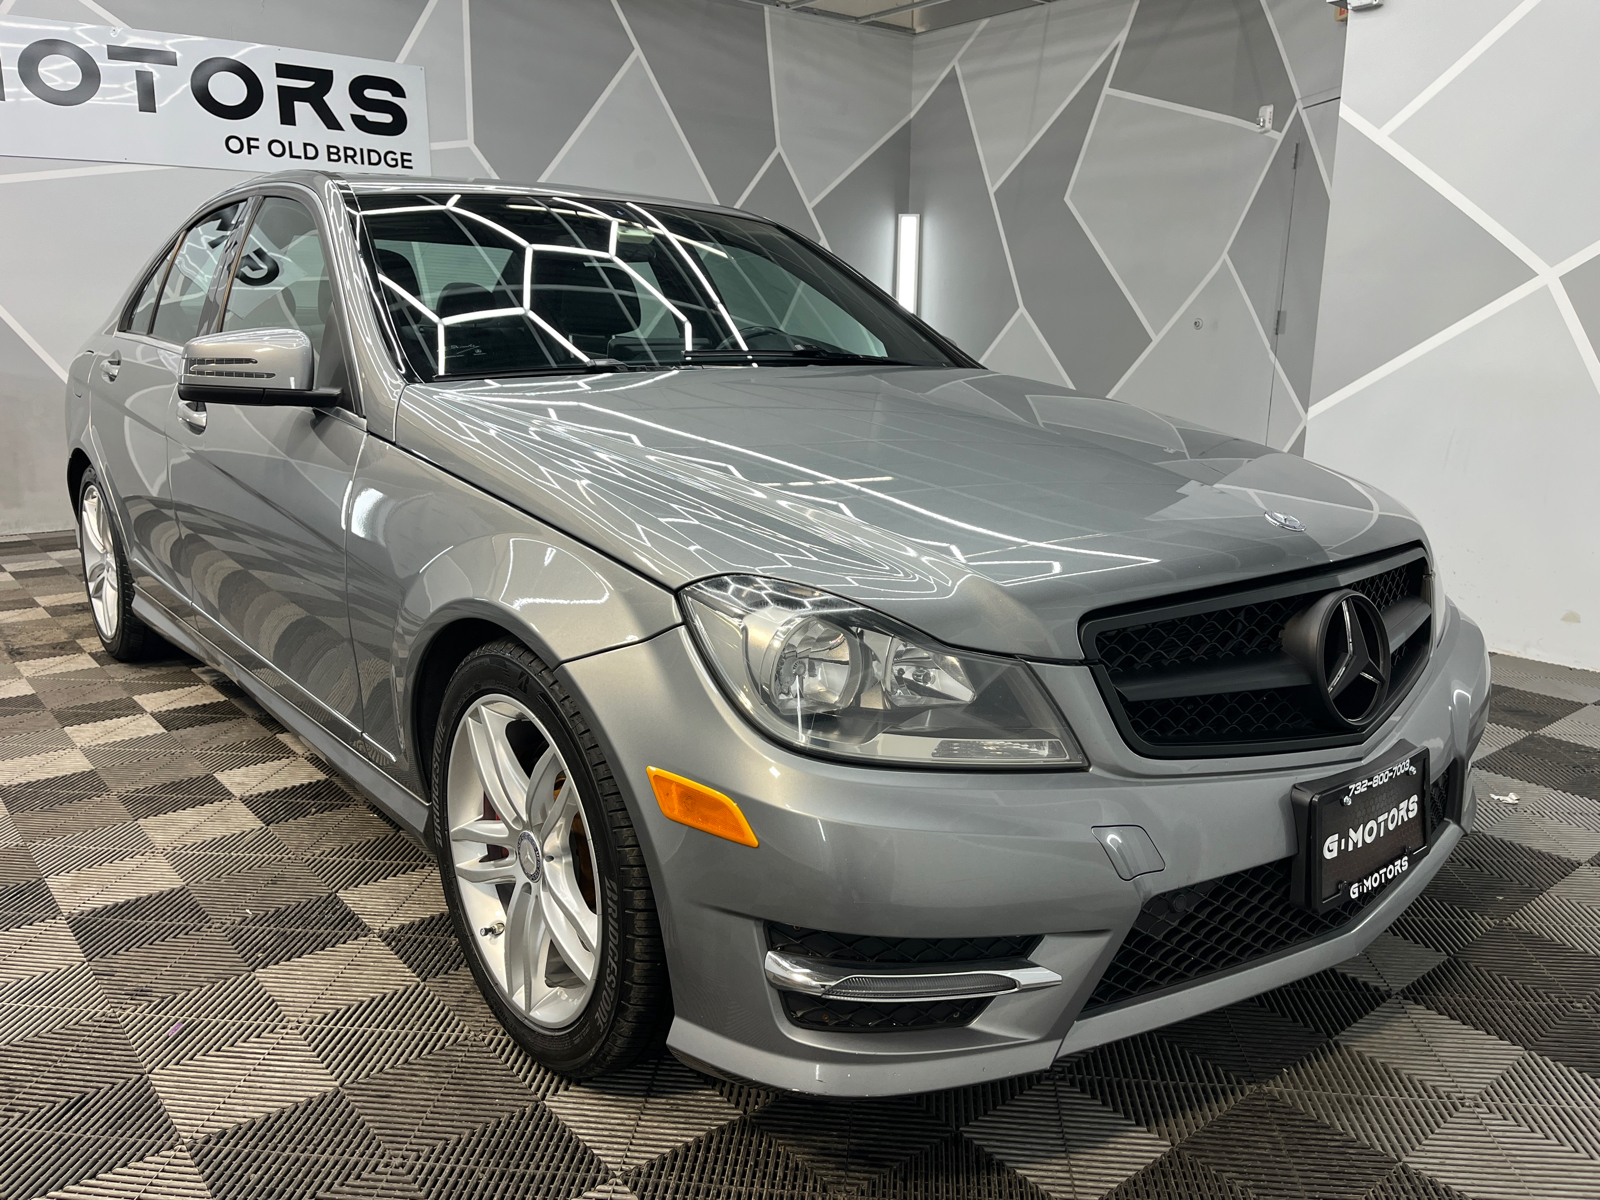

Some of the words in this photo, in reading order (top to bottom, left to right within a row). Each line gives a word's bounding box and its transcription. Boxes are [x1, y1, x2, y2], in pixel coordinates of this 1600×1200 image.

[0, 38, 408, 137] OTORS
[225, 135, 260, 155] OF
[267, 139, 319, 161] OLD
[326, 144, 413, 170] BRIDGE
[1349, 758, 1410, 797] 732-800-7003
